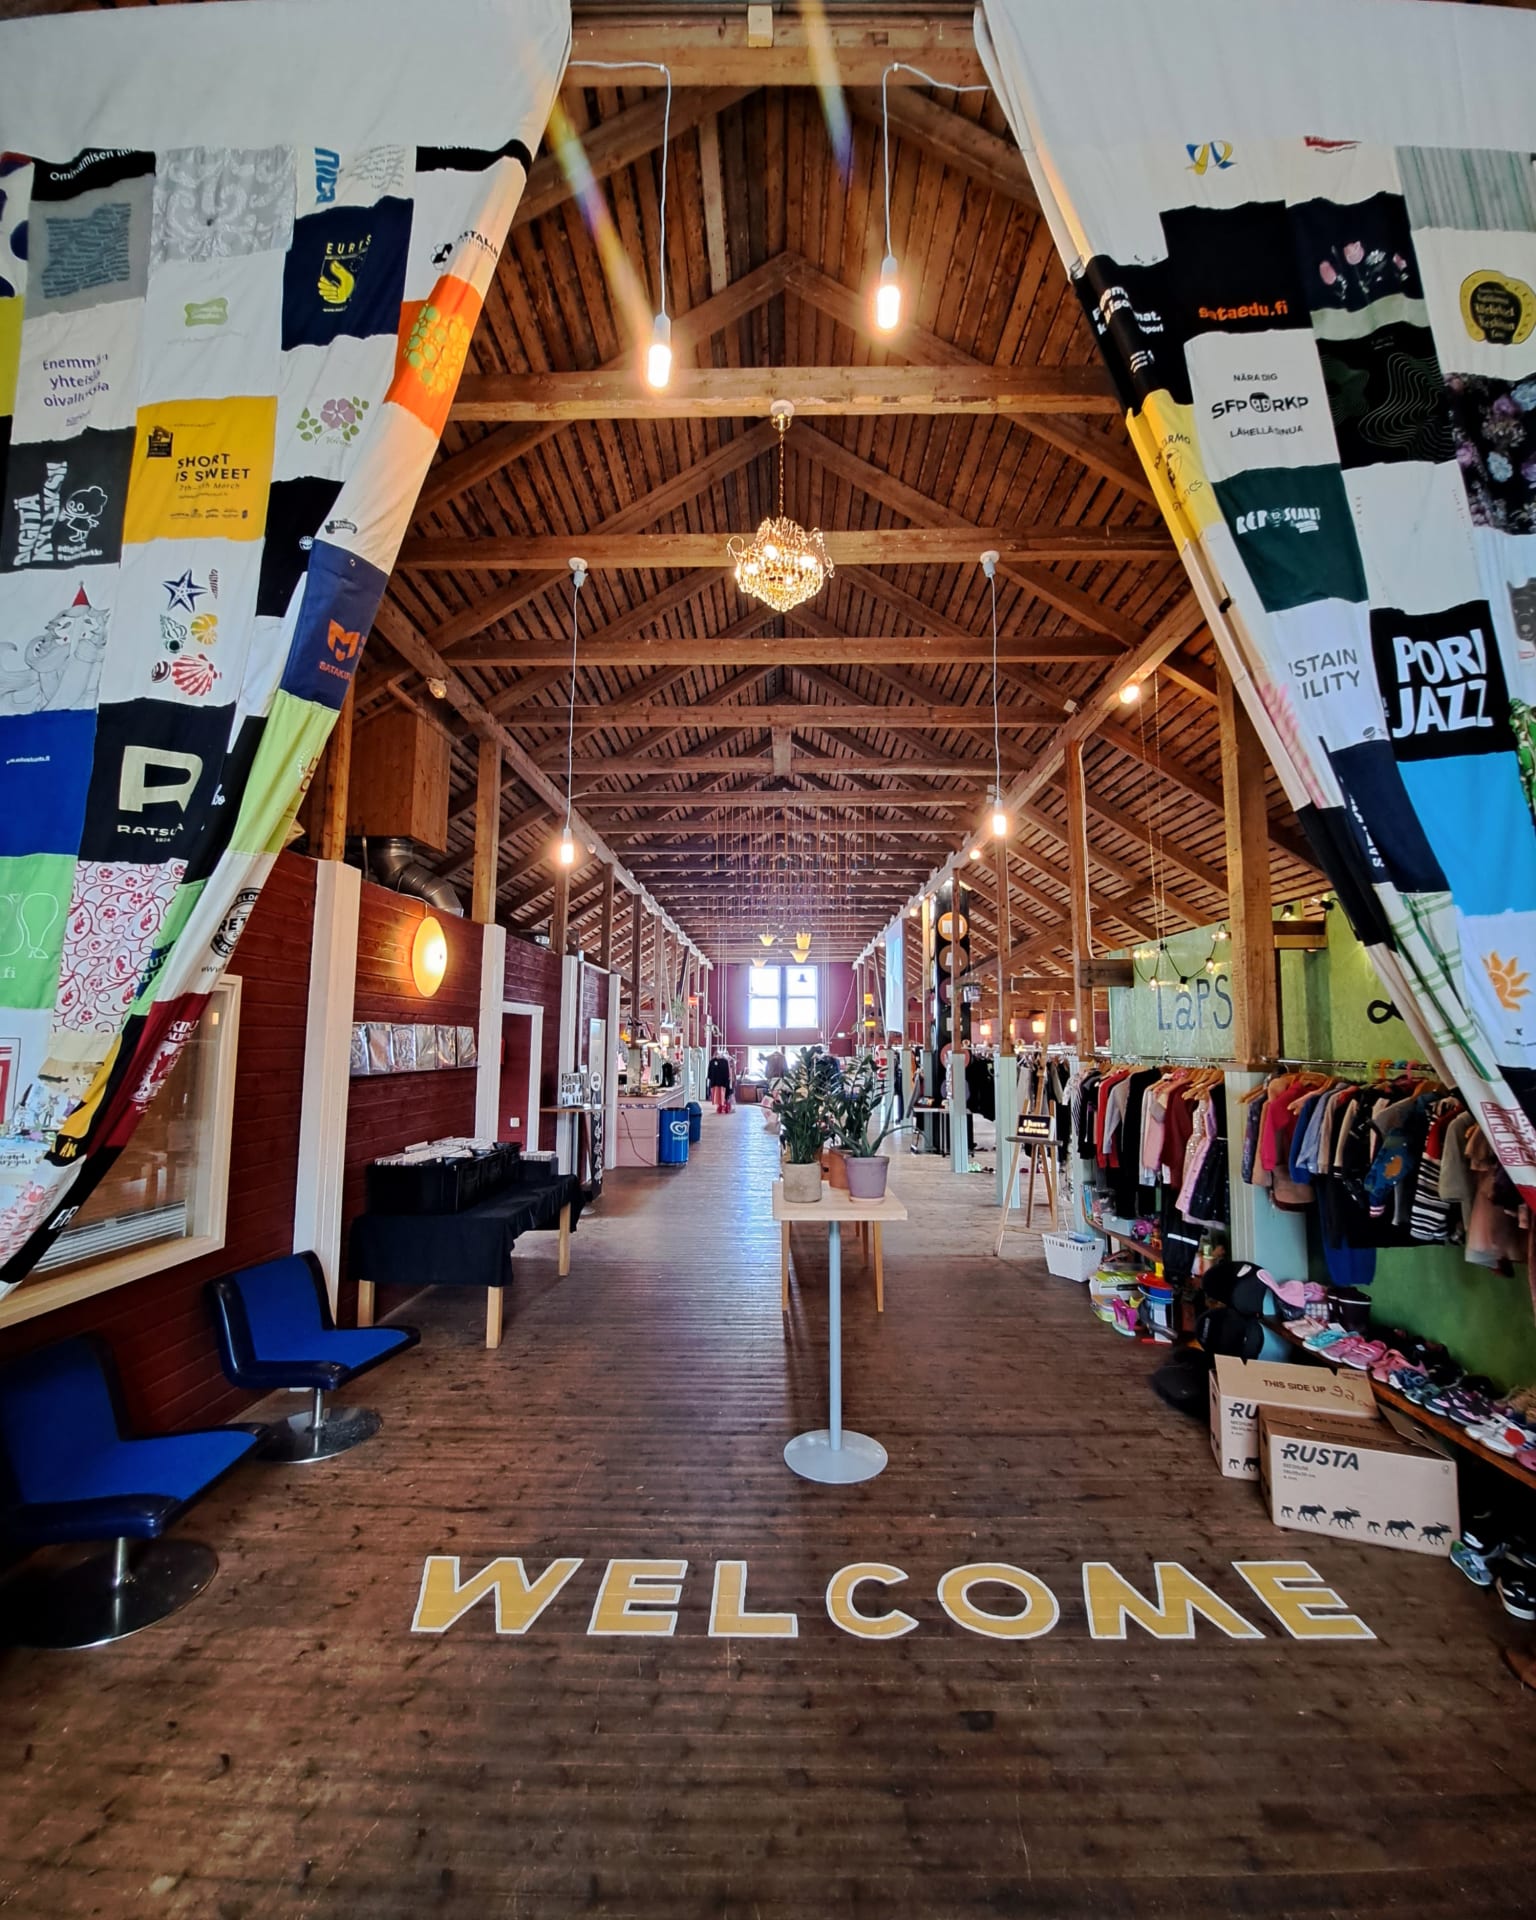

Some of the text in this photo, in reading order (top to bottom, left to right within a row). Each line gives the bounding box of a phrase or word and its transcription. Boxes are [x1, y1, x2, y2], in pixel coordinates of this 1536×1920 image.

[1212, 396, 1309, 419] SFP RKP
[178, 453, 230, 469] SHORT
[176, 468, 251, 483] IS SWEET
[1392, 628, 1487, 684] PORI
[1300, 670, 1360, 700] ILITY
[1391, 679, 1494, 738] JAZZ
[1157, 974, 1232, 1031] LaPS
[1263, 1380, 1326, 1393] THIS SIDE UP
[1281, 1443, 1359, 1470] RUSTA
[412, 1556, 1377, 1640] WELCOME
